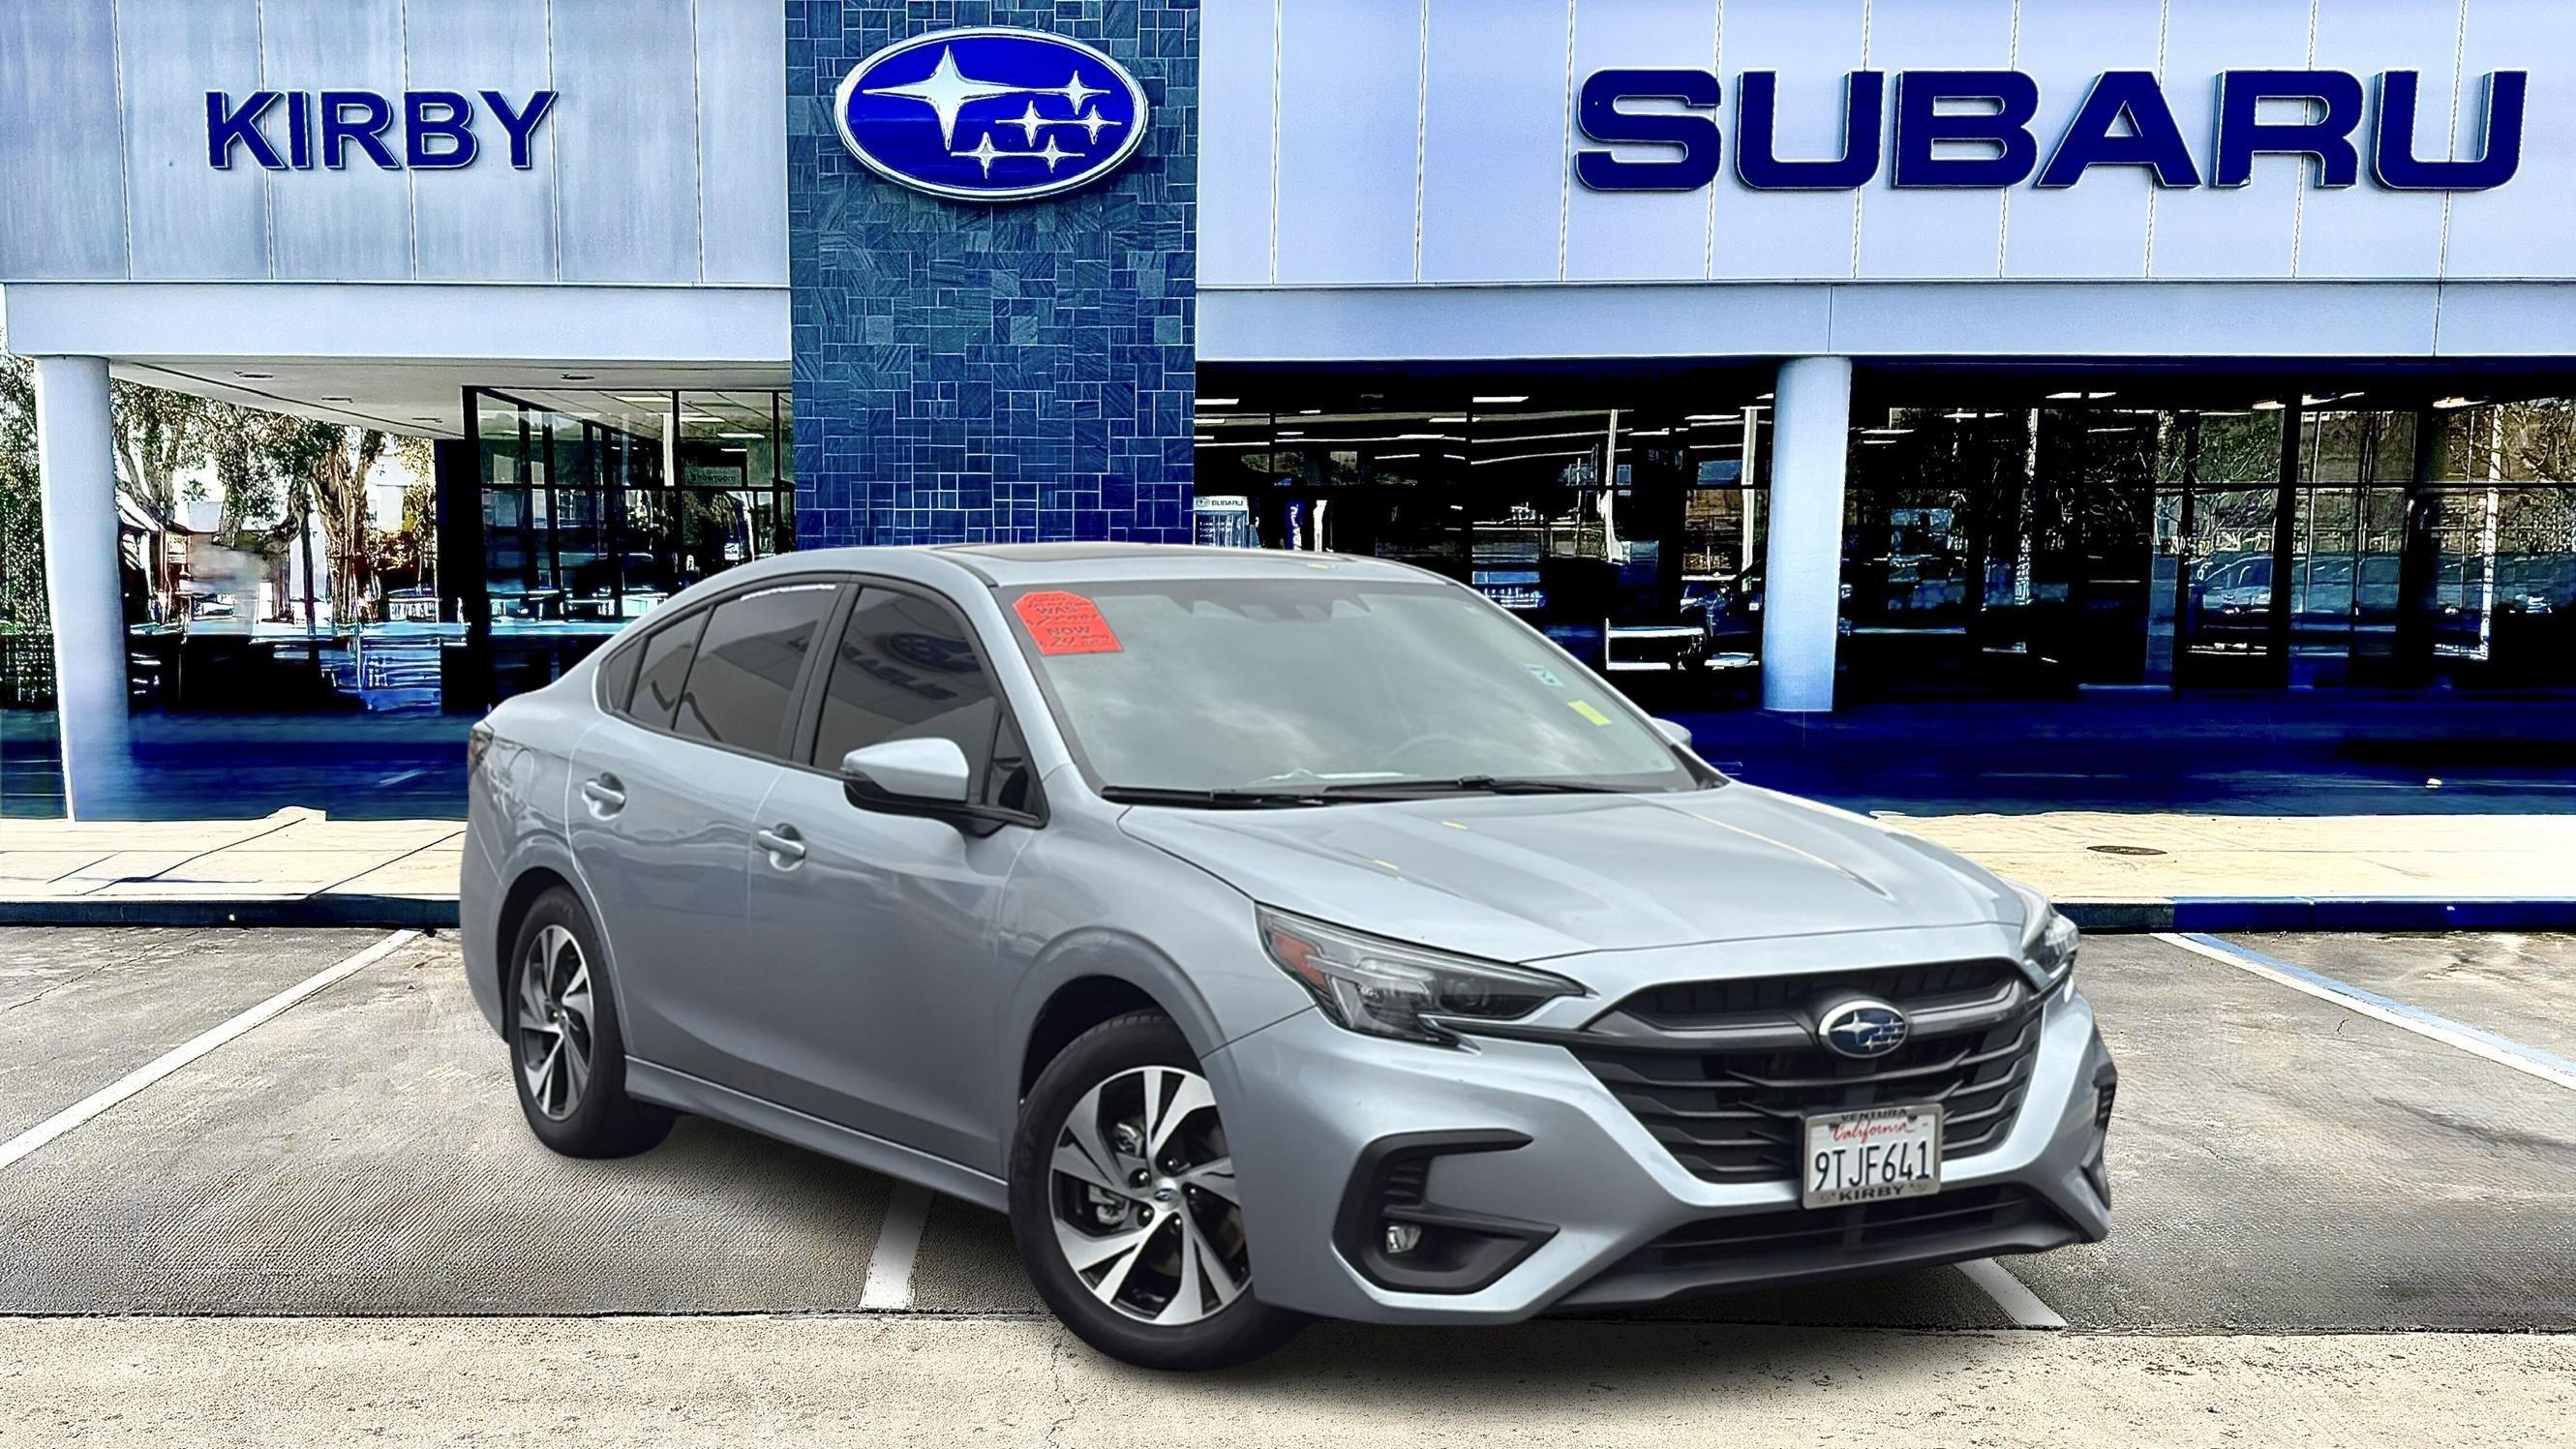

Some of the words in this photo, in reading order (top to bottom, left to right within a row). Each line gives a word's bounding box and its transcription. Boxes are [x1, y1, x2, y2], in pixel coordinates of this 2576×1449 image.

[204, 90, 560, 170] KIRBY
[1575, 69, 2529, 191] SUBARU
[1036, 606, 1078, 615] WAS
[1046, 625, 1091, 636] NOW
[1840, 1108, 1908, 1122] VENTURA
[1833, 1122, 1916, 1144] California
[1814, 1140, 1930, 1192] 9TJF641
[1838, 1184, 1905, 1201] KIRBY
